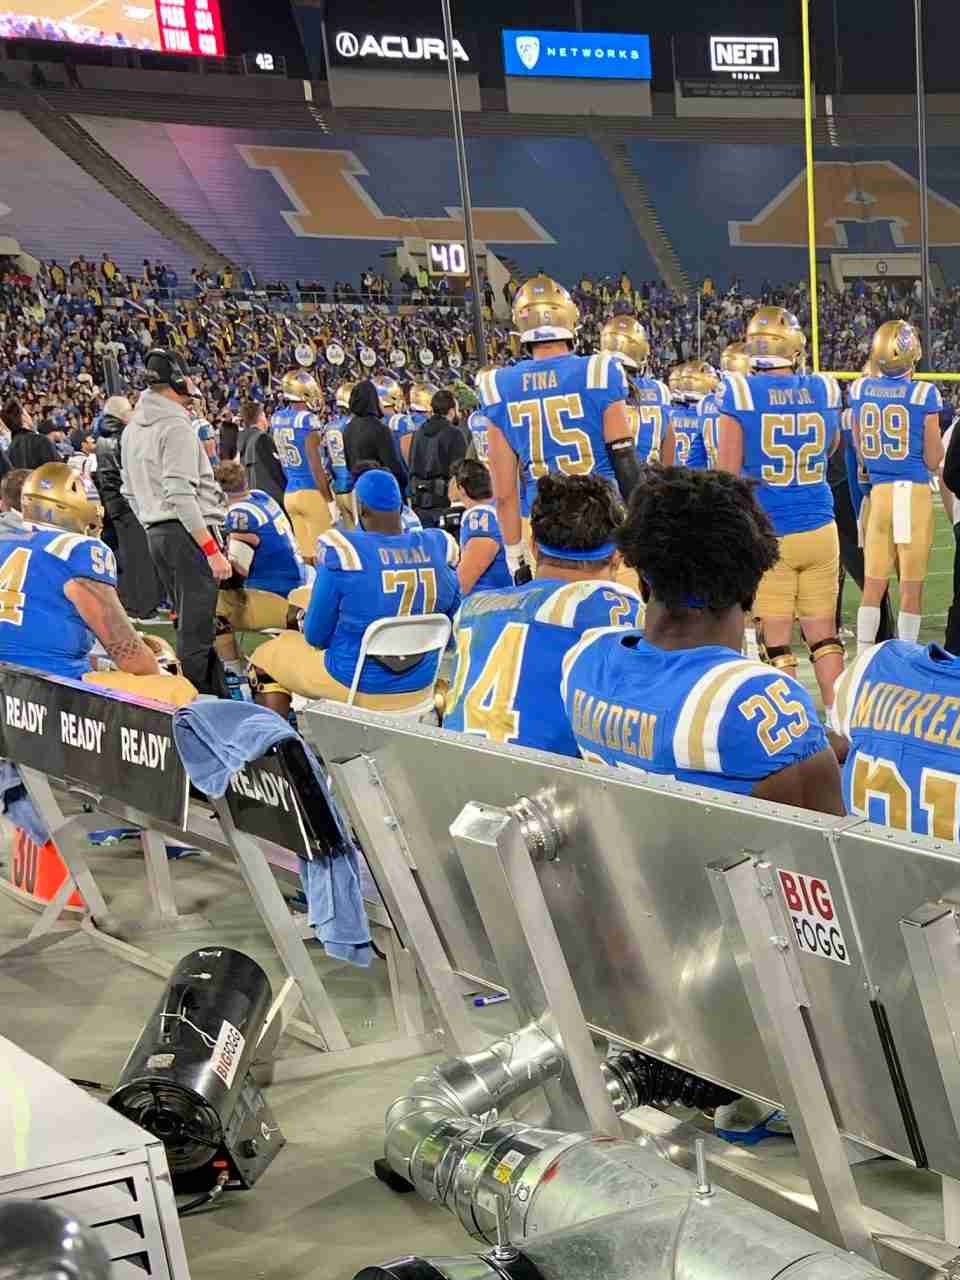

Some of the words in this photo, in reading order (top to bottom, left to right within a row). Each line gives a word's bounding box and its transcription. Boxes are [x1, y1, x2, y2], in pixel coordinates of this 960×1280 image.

[255, 52, 274, 70] 42
[358, 35, 469, 61] ACURA
[547, 46, 640, 60] NETWORKS
[716, 43, 772, 65] NEFT
[430, 243, 466, 273] 40
[523, 370, 557, 391] FINA
[507, 392, 595, 479] 75
[760, 412, 827, 487] 52
[860, 402, 910, 461] 89
[90, 546, 116, 575] 54
[0, 547, 34, 626] 4
[382, 568, 438, 618] 71
[738, 678, 809, 757] 25
[778, 871, 834, 920] BIG
[792, 917, 846, 960] FOGG
